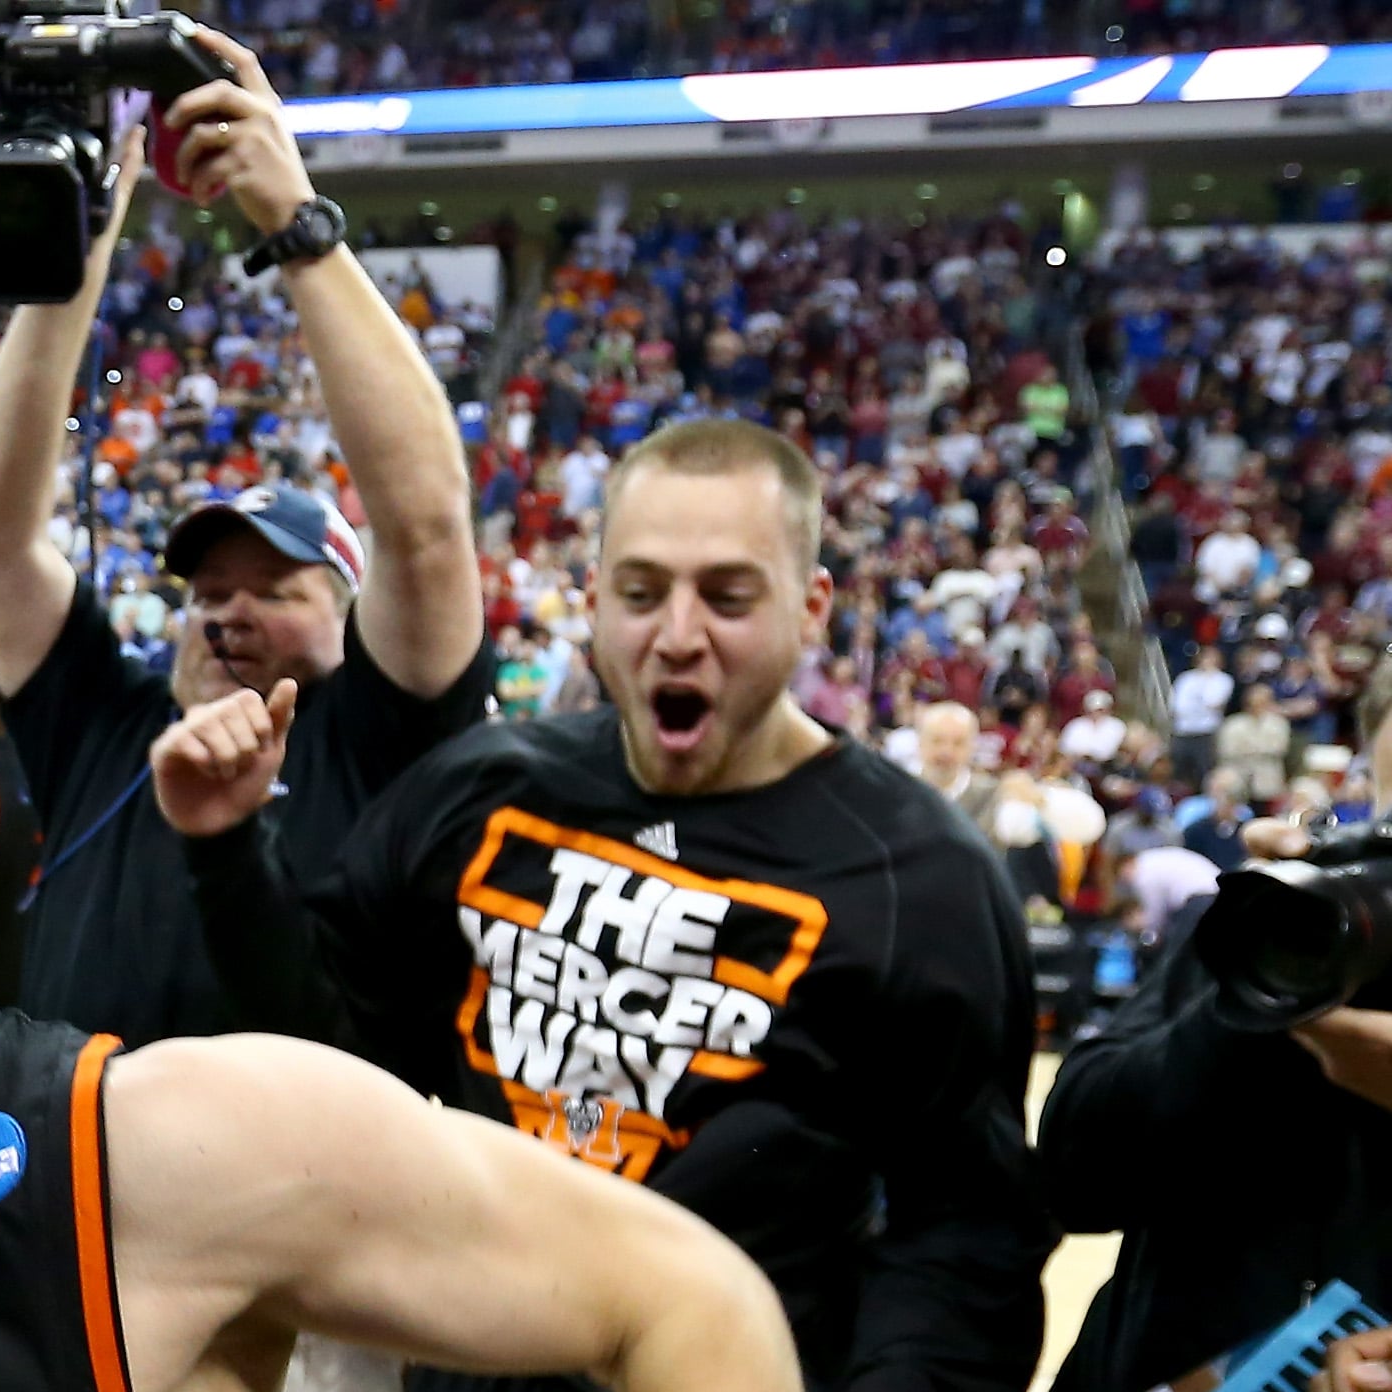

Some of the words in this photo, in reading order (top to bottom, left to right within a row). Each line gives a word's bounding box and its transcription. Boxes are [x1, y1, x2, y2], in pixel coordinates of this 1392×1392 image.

[538, 847, 731, 979] THE
[458, 905, 773, 1057] MERCER
[486, 987, 694, 1120] WAY
